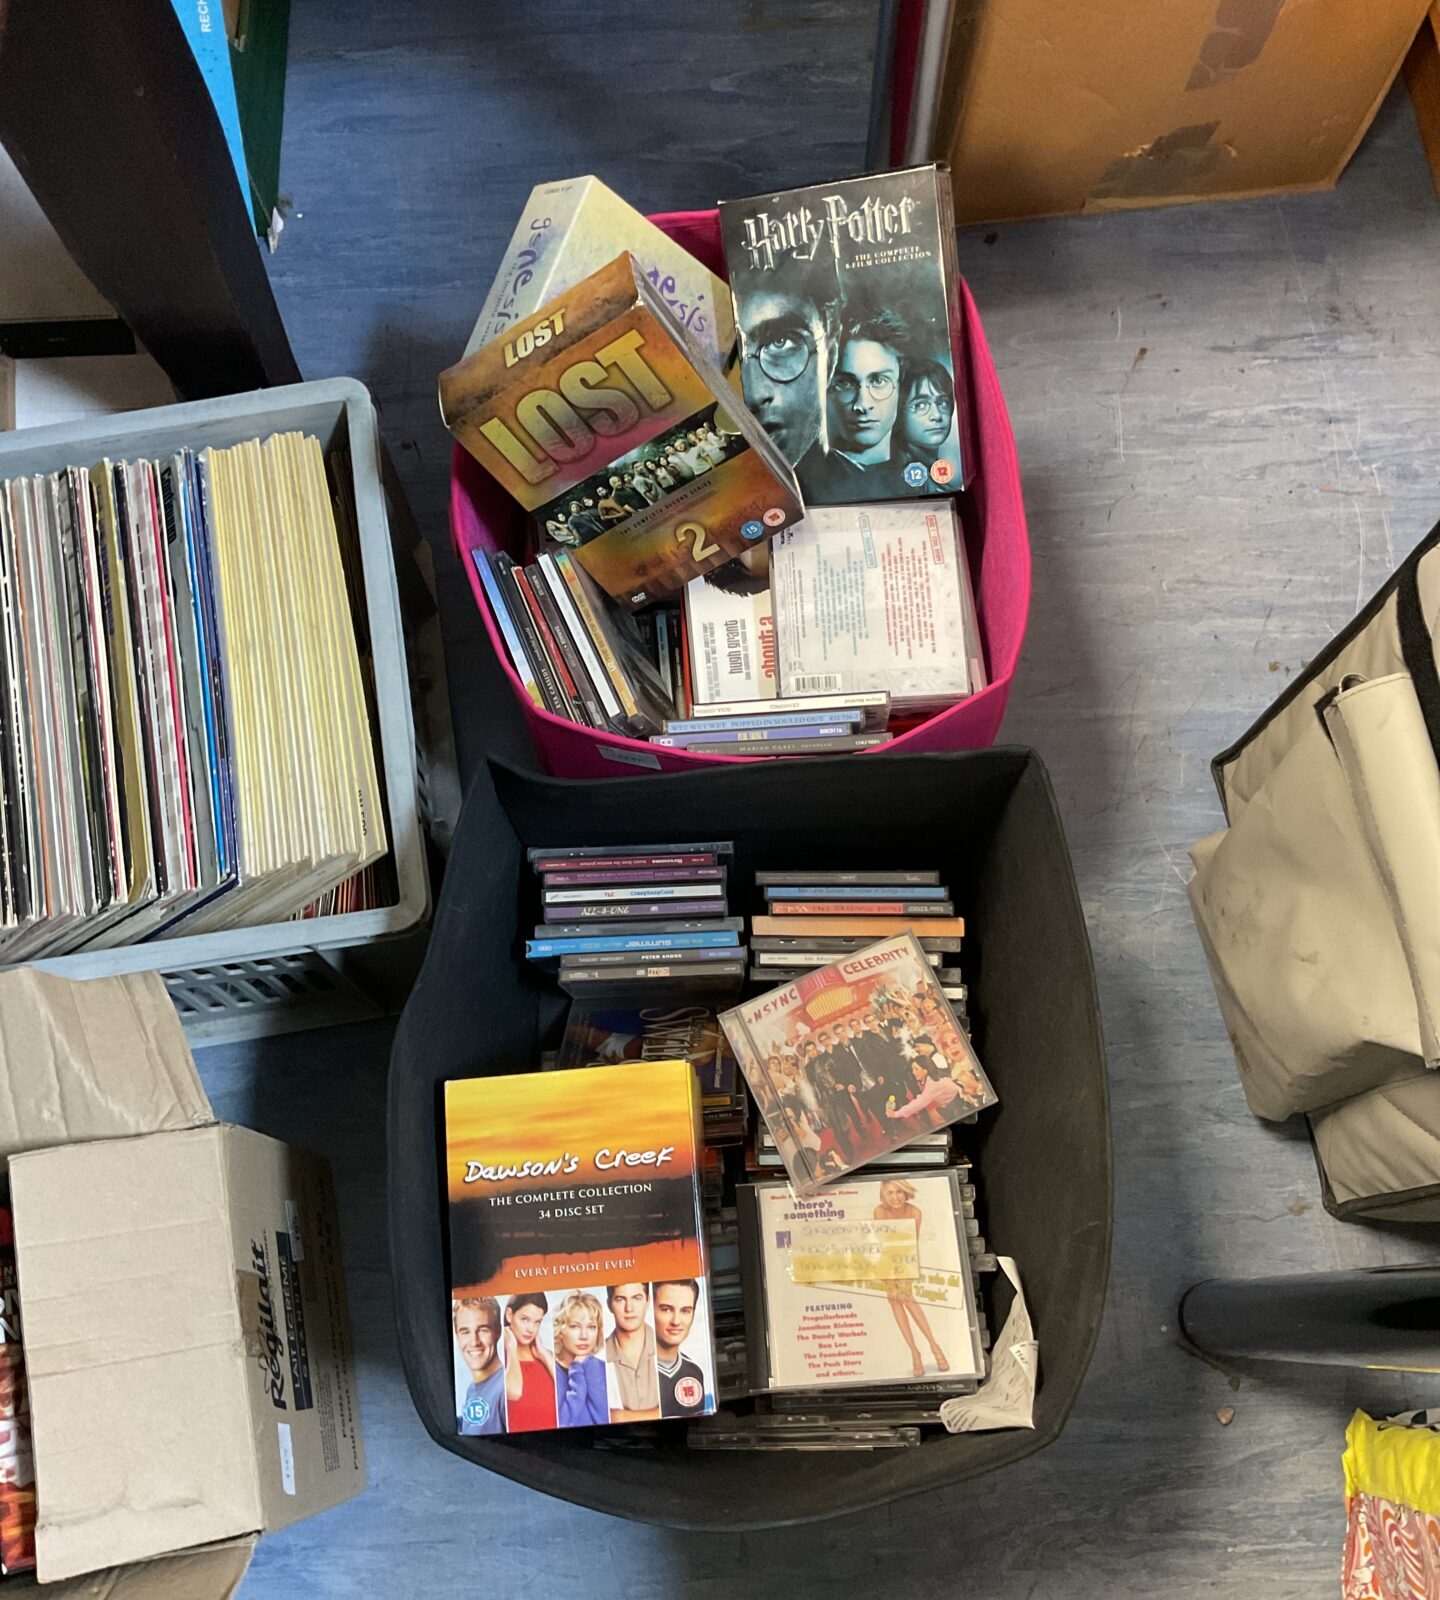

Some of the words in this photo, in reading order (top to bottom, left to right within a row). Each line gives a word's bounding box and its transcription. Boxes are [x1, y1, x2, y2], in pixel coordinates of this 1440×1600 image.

[741, 207, 824, 272] Harry
[822, 194, 916, 260] Potter
[875, 250, 932, 266] COLLECTION
[503, 308, 566, 369] LOST
[479, 328, 673, 486] LOST
[675, 521, 721, 563] 2
[724, 619, 741, 649] grant
[726, 650, 744, 675] hugh
[625, 939, 672, 948] summer
[842, 946, 910, 976] CELEBRITY
[464, 1152, 580, 1184] Dawson's
[594, 1146, 676, 1171] Creek
[489, 1197, 513, 1207] THE
[515, 1190, 576, 1205] COMPLETE
[579, 1183, 653, 1199] COLLECTION
[538, 1209, 551, 1220] 34
[554, 1207, 582, 1218] DISC
[585, 1204, 605, 1215] SET
[793, 1199, 834, 1210] there's
[783, 1208, 845, 1221] something
[514, 1267, 549, 1279] EVERY
[552, 1262, 601, 1276] EPISODE
[604, 1259, 636, 1271] EVER!
[805, 1303, 853, 1313] FEATURING
[802, 1312, 858, 1322] Propellerheads
[798, 1322, 832, 1332] Jonathan
[833, 1321, 865, 1330] Richman
[812, 1333, 836, 1341] Dandy
[819, 1350, 864, 1359] Foundations
[816, 1370, 830, 1378] and
